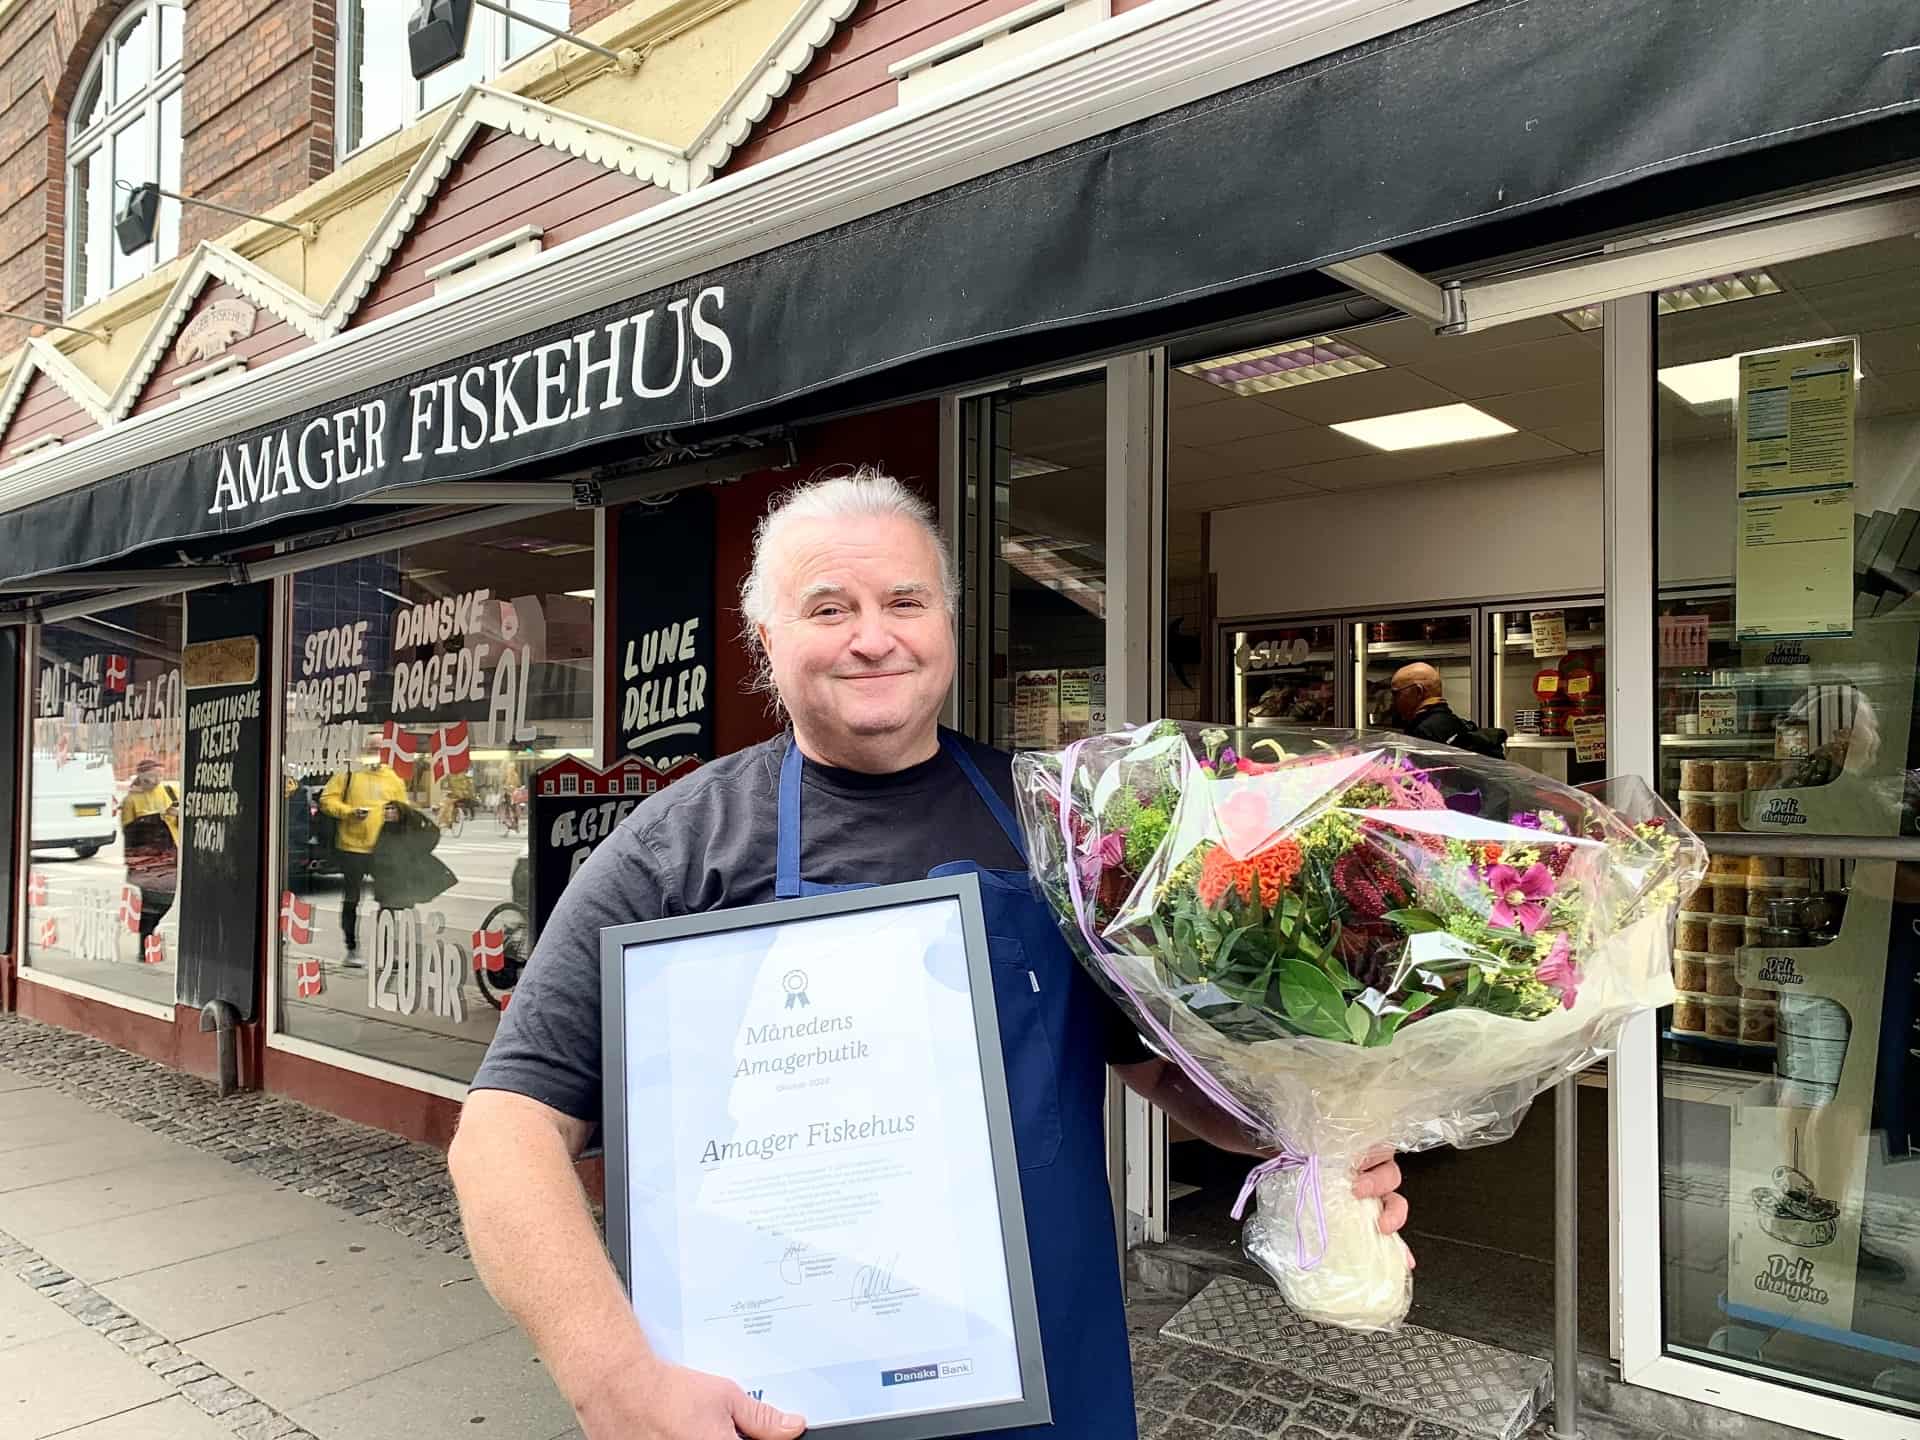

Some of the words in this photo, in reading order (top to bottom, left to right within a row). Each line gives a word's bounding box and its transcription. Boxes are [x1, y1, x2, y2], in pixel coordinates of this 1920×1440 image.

[208, 400, 387, 515] AMAGER
[403, 286, 732, 463] FISKEHUS
[395, 588, 490, 651] DANSKE
[303, 621, 368, 676] STORE
[623, 617, 700, 681] LUNE
[392, 644, 490, 714] RØGEDE
[622, 664, 708, 734] DELLER
[189, 689, 260, 731] ARGENTINSKE
[200, 721, 240, 760] REJER
[194, 762, 234, 788] FROSEN
[1770, 798, 1799, 814] Deli
[368, 908, 416, 1016] 120
[1767, 957, 1795, 973] Deli
[745, 1013, 853, 1046] Månedens
[734, 1040, 869, 1078] Amagerbutik
[700, 1132, 798, 1166] Amager
[806, 1112, 916, 1148] Fiskehus
[1755, 1271, 1829, 1305] drengene
[1768, 1254, 1815, 1287] Deli
[893, 1368, 936, 1383] Danske
[941, 1362, 970, 1376] Bank
